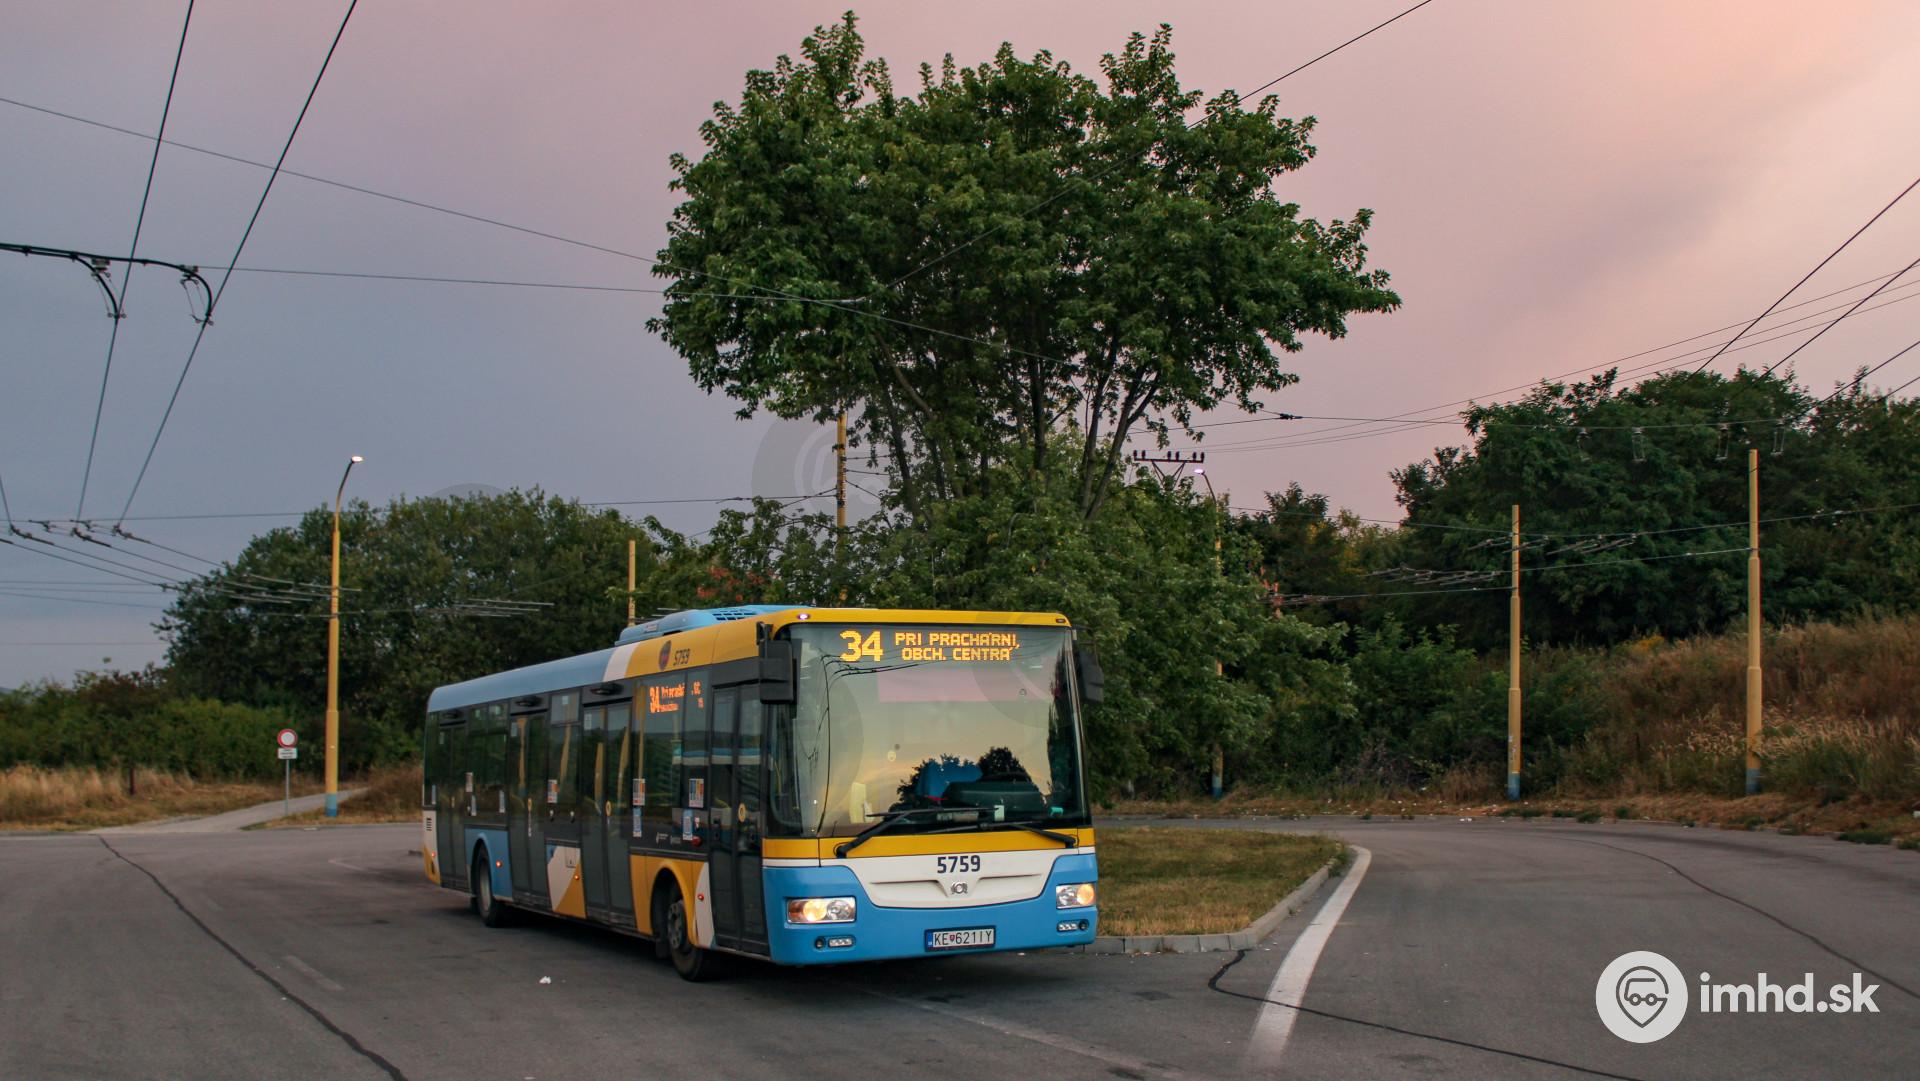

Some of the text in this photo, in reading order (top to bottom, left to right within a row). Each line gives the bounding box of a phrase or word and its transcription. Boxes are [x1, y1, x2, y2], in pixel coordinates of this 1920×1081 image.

[839, 629, 883, 662] 34
[895, 632, 922, 646] PRI
[673, 648, 691, 666] 5759
[902, 647, 947, 661] OBCH.
[937, 855, 981, 874] 5759
